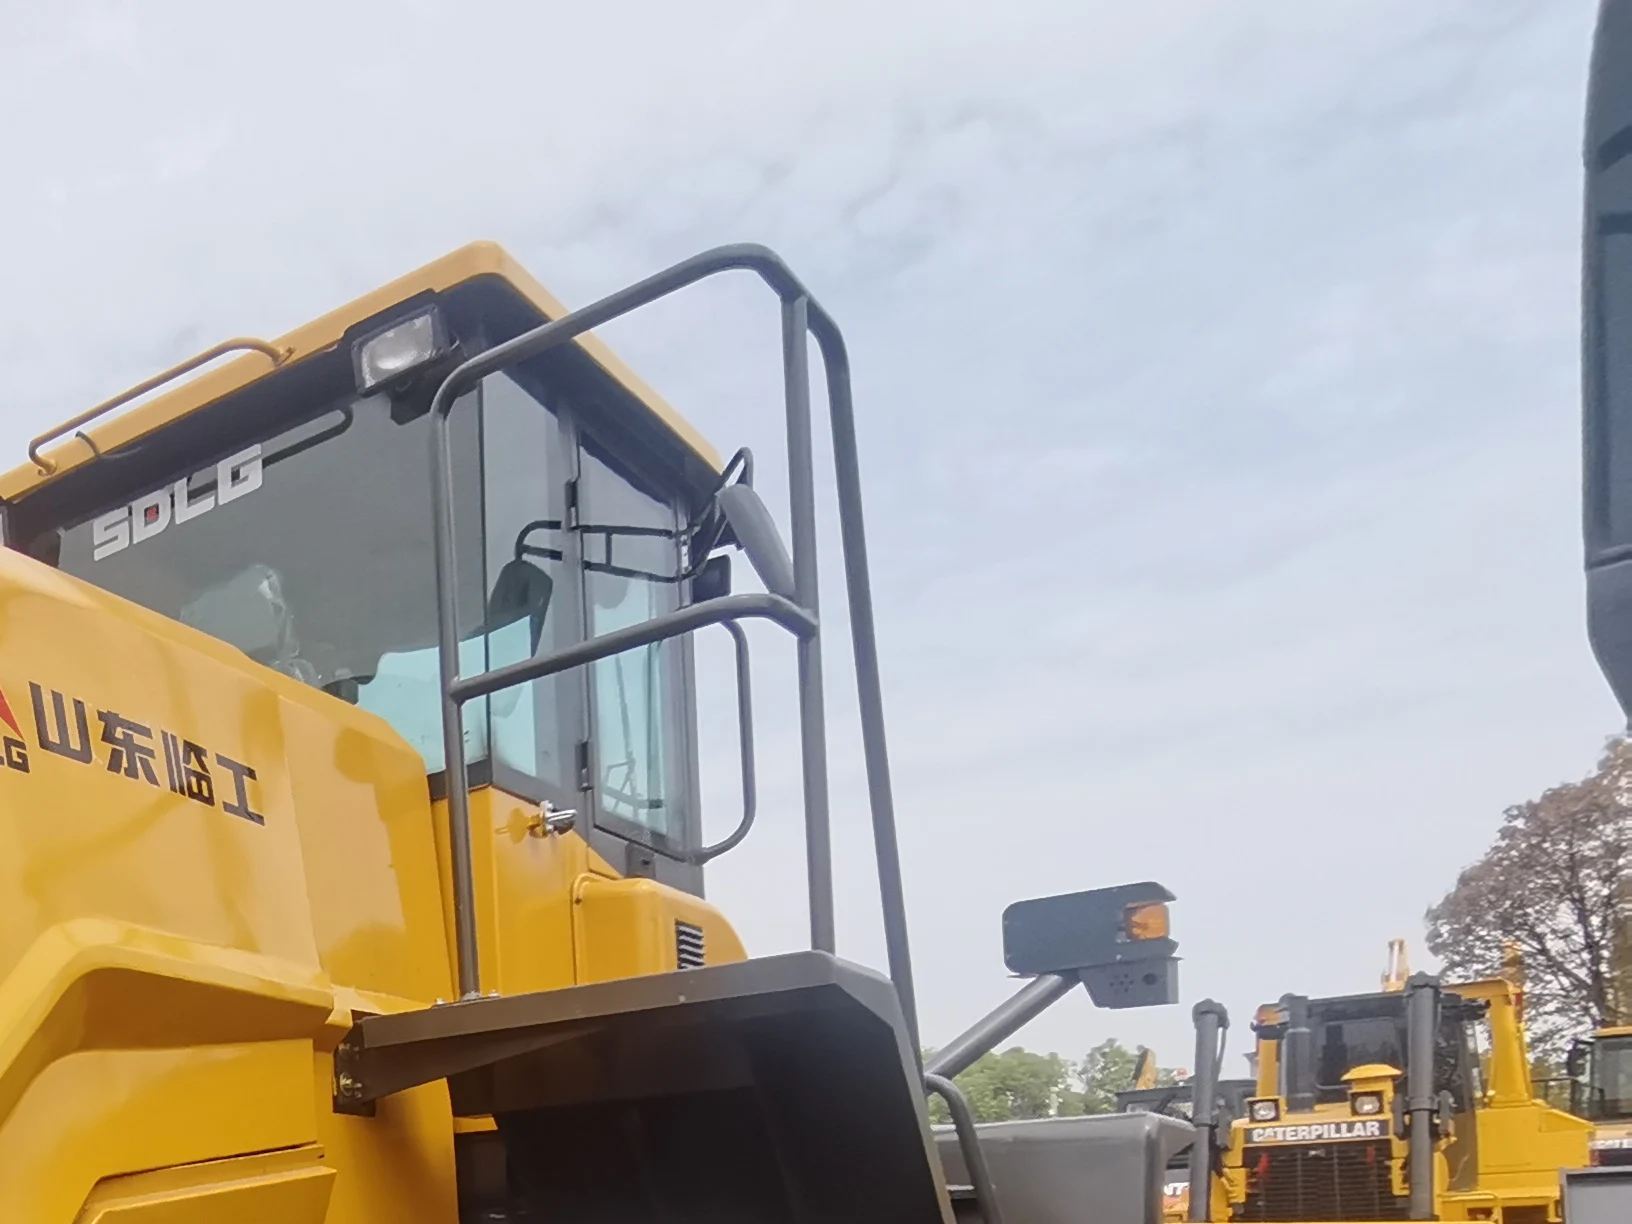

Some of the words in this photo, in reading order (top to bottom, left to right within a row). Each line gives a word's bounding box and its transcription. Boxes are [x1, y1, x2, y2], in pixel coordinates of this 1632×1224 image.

[93, 443, 263, 562] SDLG
[29, 681, 266, 826] 山东临工
[1251, 1121, 1381, 1143] CATERPILLAR
